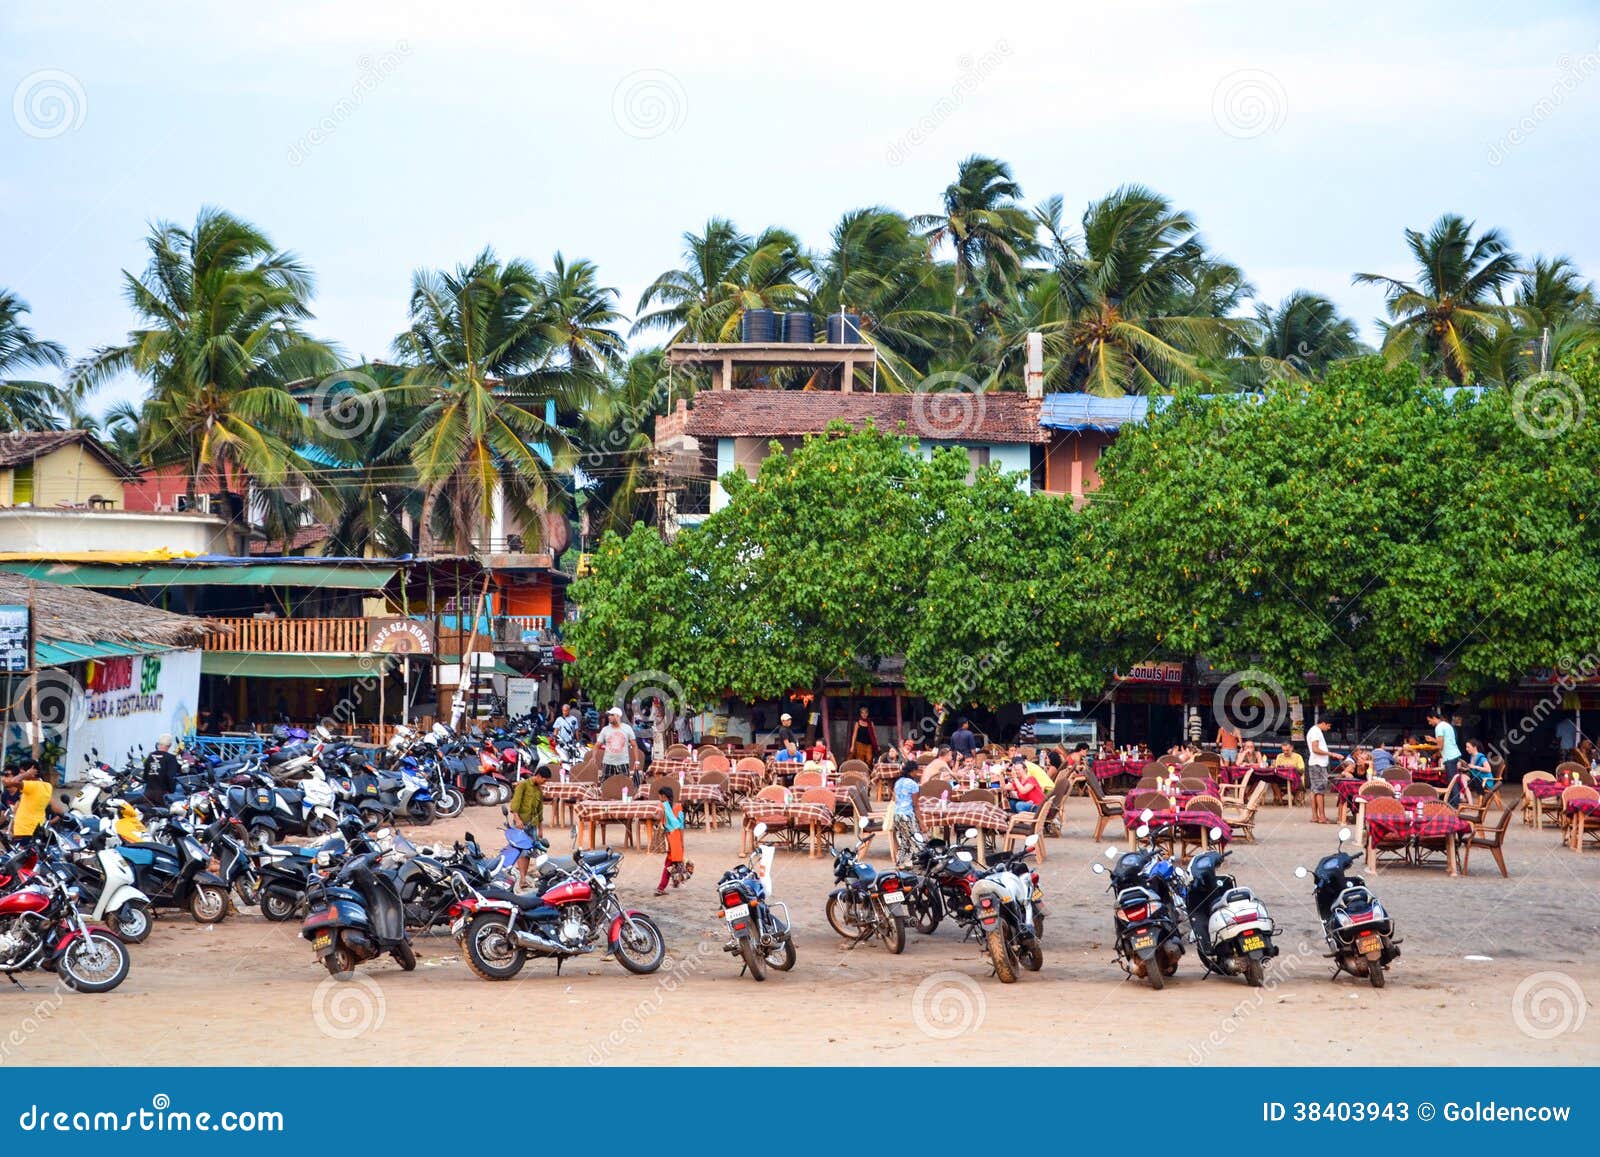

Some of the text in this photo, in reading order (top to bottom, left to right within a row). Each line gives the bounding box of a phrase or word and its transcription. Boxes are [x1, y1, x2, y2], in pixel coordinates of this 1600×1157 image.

[390, 622, 407, 633] SEA
[410, 624, 430, 653] HORSE
[1165, 665, 1181, 681] Inn
[116, 694, 163, 717] RESTAURANT
